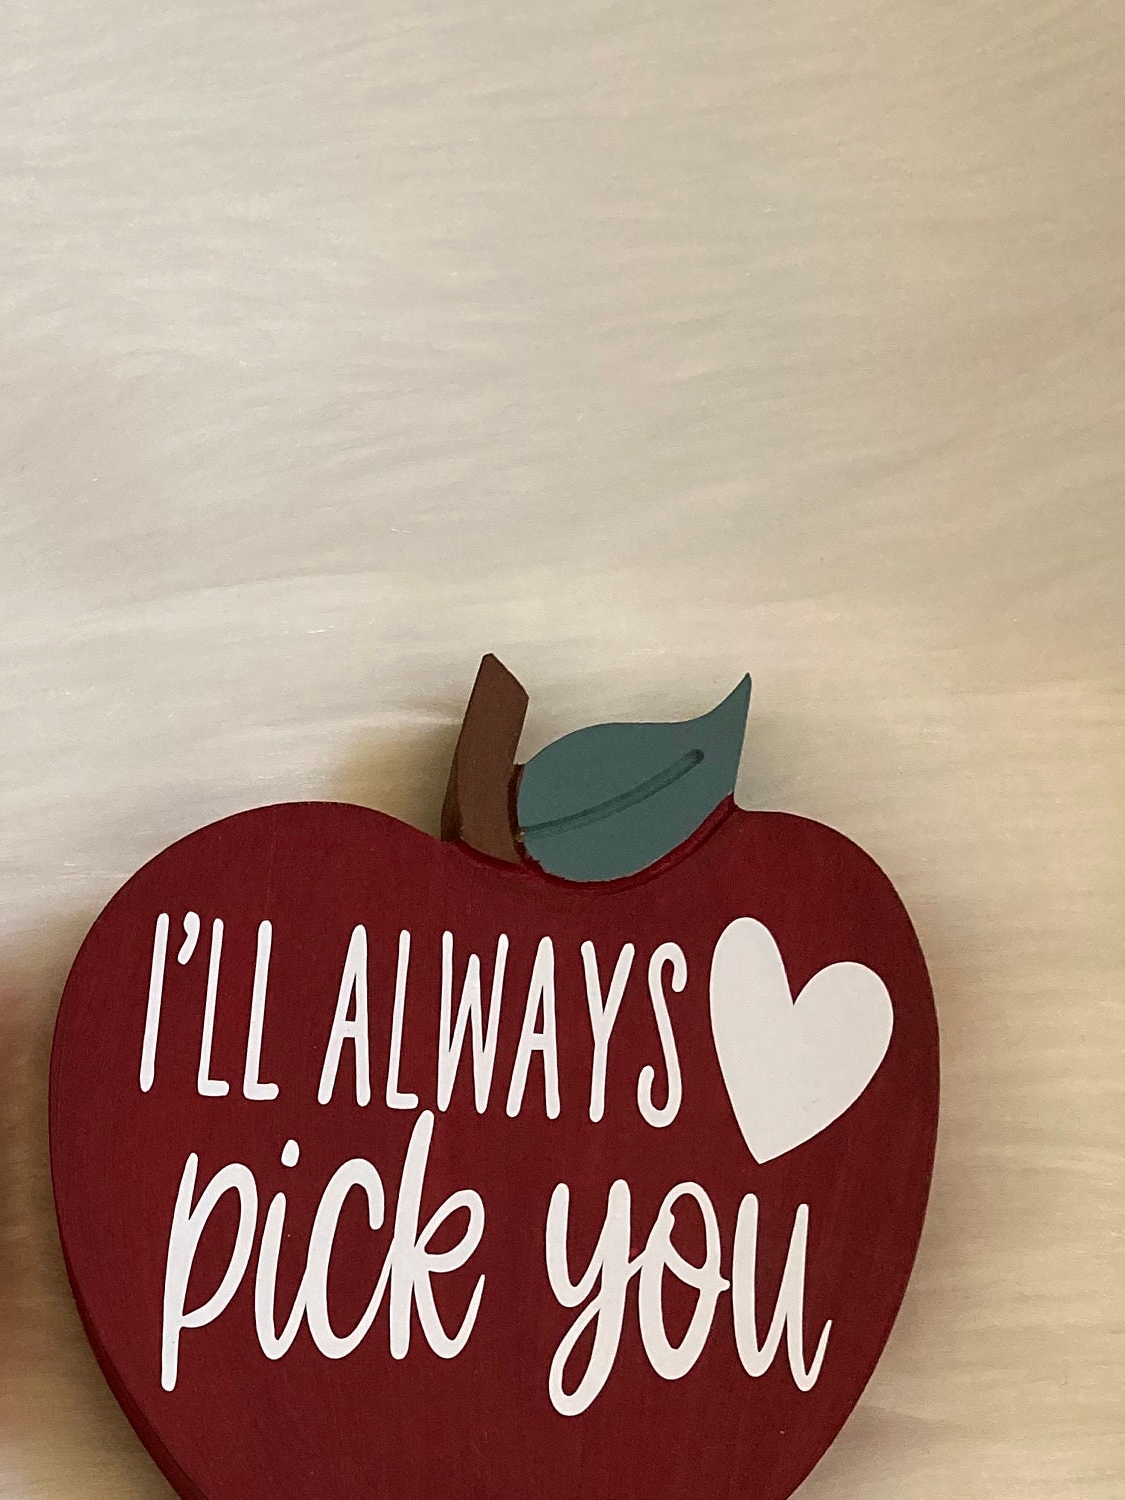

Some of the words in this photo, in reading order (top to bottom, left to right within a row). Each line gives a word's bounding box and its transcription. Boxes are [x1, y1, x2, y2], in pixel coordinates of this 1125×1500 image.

[140, 912, 279, 1100] I'LL
[318, 925, 687, 1127] ALWAYS
[161, 1110, 485, 1391] pick
[546, 1179, 832, 1416] you
